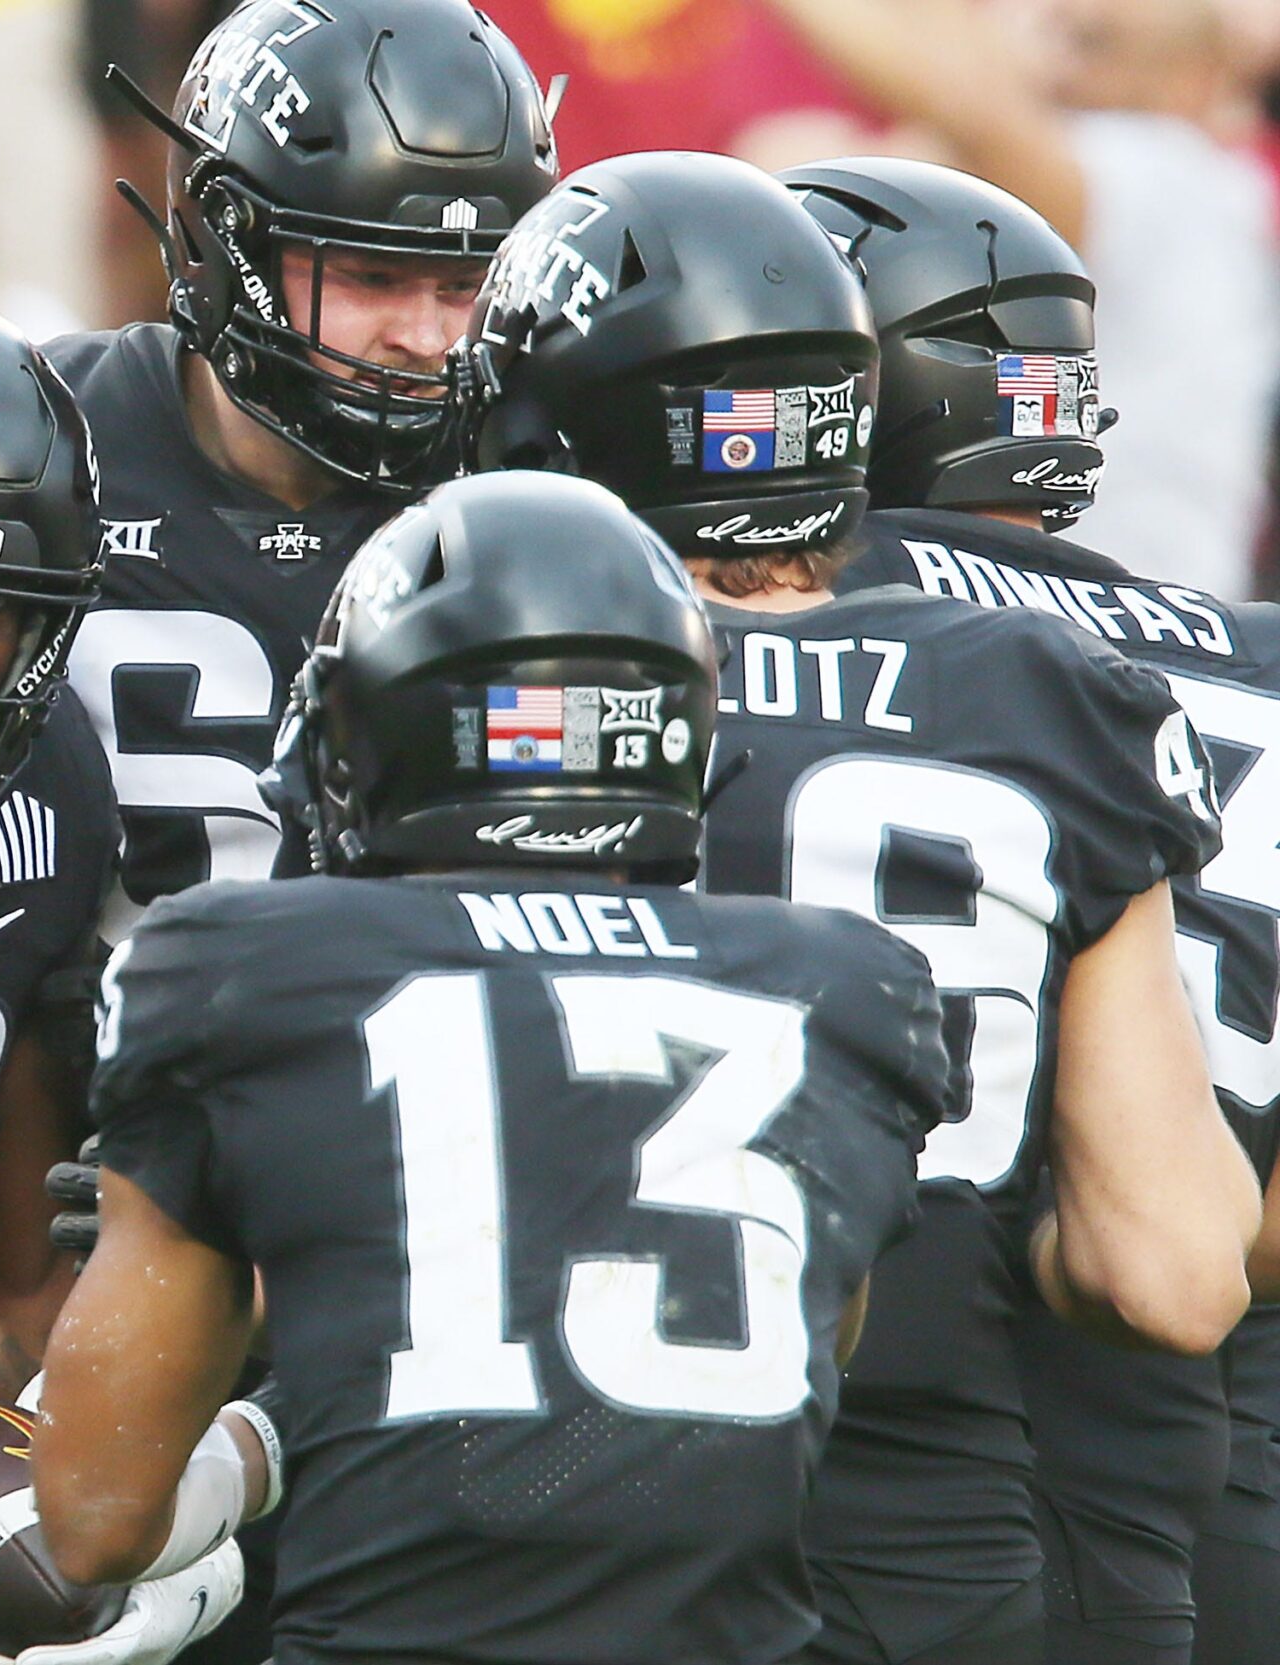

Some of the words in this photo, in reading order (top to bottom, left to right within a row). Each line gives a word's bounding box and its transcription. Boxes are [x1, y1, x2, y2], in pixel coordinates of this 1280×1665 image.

[810, 382, 853, 424] XII
[815, 427, 850, 459] 49
[258, 533, 322, 551] STATE
[605, 691, 659, 730] XII
[612, 734, 649, 769] 13
[1154, 709, 1221, 822] 4
[457, 892, 699, 959] NOEL
[362, 972, 811, 1418] 13
